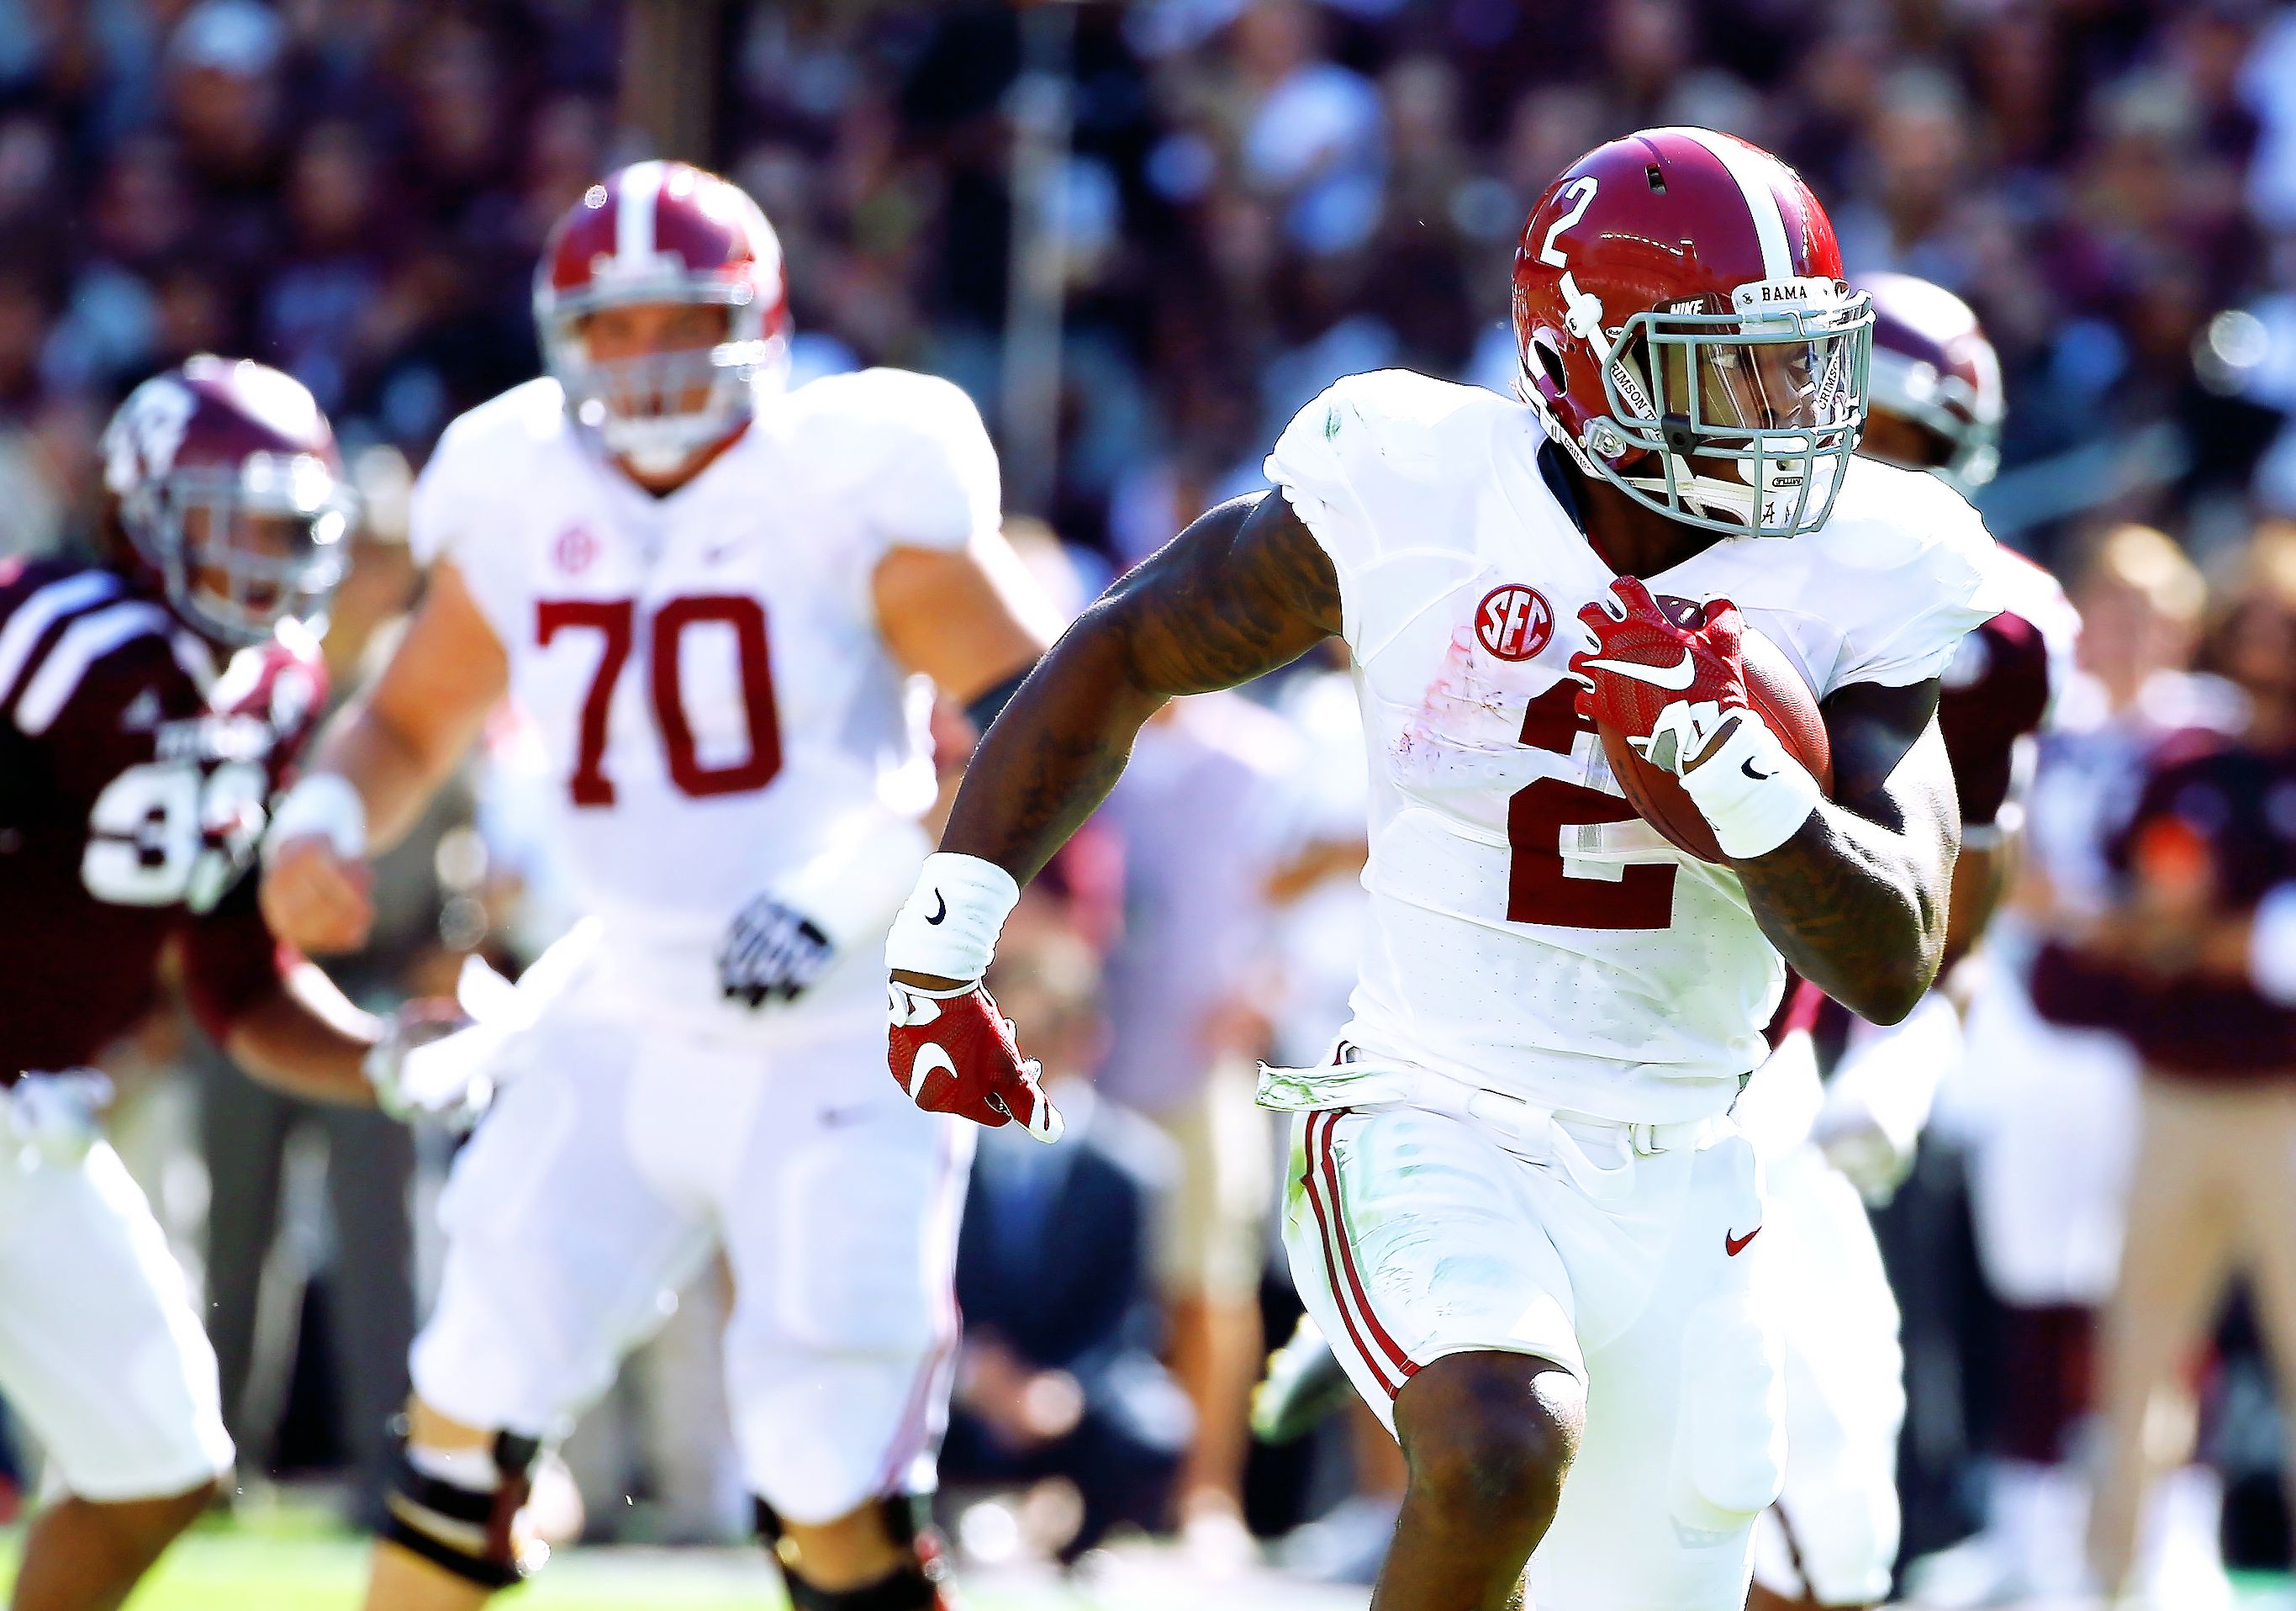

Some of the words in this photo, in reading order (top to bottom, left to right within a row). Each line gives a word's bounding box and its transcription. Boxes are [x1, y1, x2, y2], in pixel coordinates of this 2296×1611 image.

[1539, 175, 1599, 270] 2
[1670, 298, 1704, 315] NIKE
[1761, 285, 1808, 302] BAMA
[1611, 362, 1648, 410] RIMSON
[1818, 357, 1839, 410] CRIMS
[1481, 589, 1549, 656] SEC
[535, 594, 784, 808] 70
[1506, 677, 1680, 930] 2
